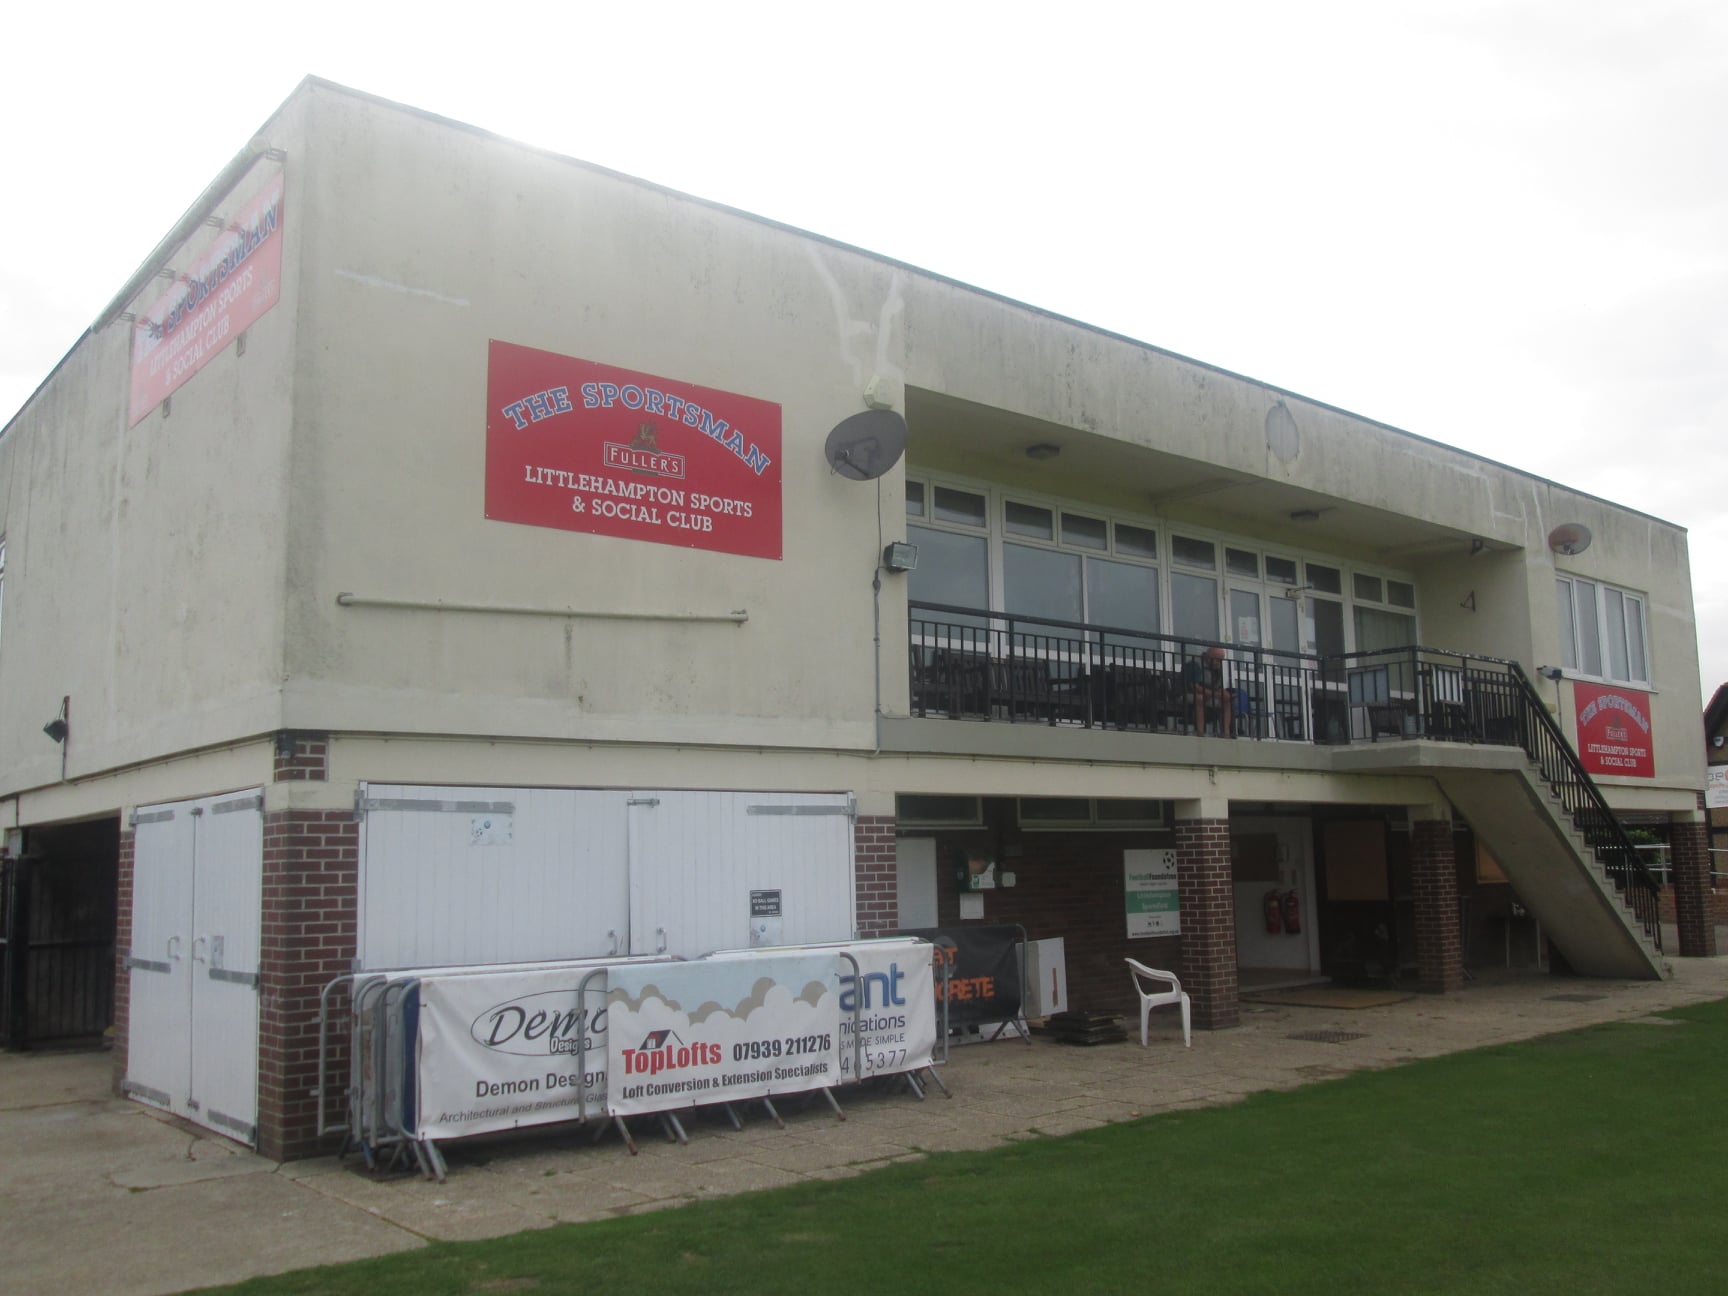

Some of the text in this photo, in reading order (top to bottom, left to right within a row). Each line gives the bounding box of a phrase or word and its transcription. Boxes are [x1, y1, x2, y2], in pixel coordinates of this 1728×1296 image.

[502, 382, 771, 476] THE SPORTSMAN
[609, 447, 679, 473] FULLER'S
[525, 465, 753, 518] LITTLEHAMPTON SPORTS
[572, 496, 713, 532] & SOCIAL CLUB
[550, 1036, 592, 1056] Desigs
[622, 1034, 831, 1075] TopLofts 07939 211276
[875, 1033, 905, 1046] SIMPLE
[475, 1070, 607, 1097] Demon Desgn
[622, 1061, 828, 1099] Loft Conversion & Extension Specialists
[439, 1101, 510, 1123] Architectural
[512, 1104, 532, 1114] and
